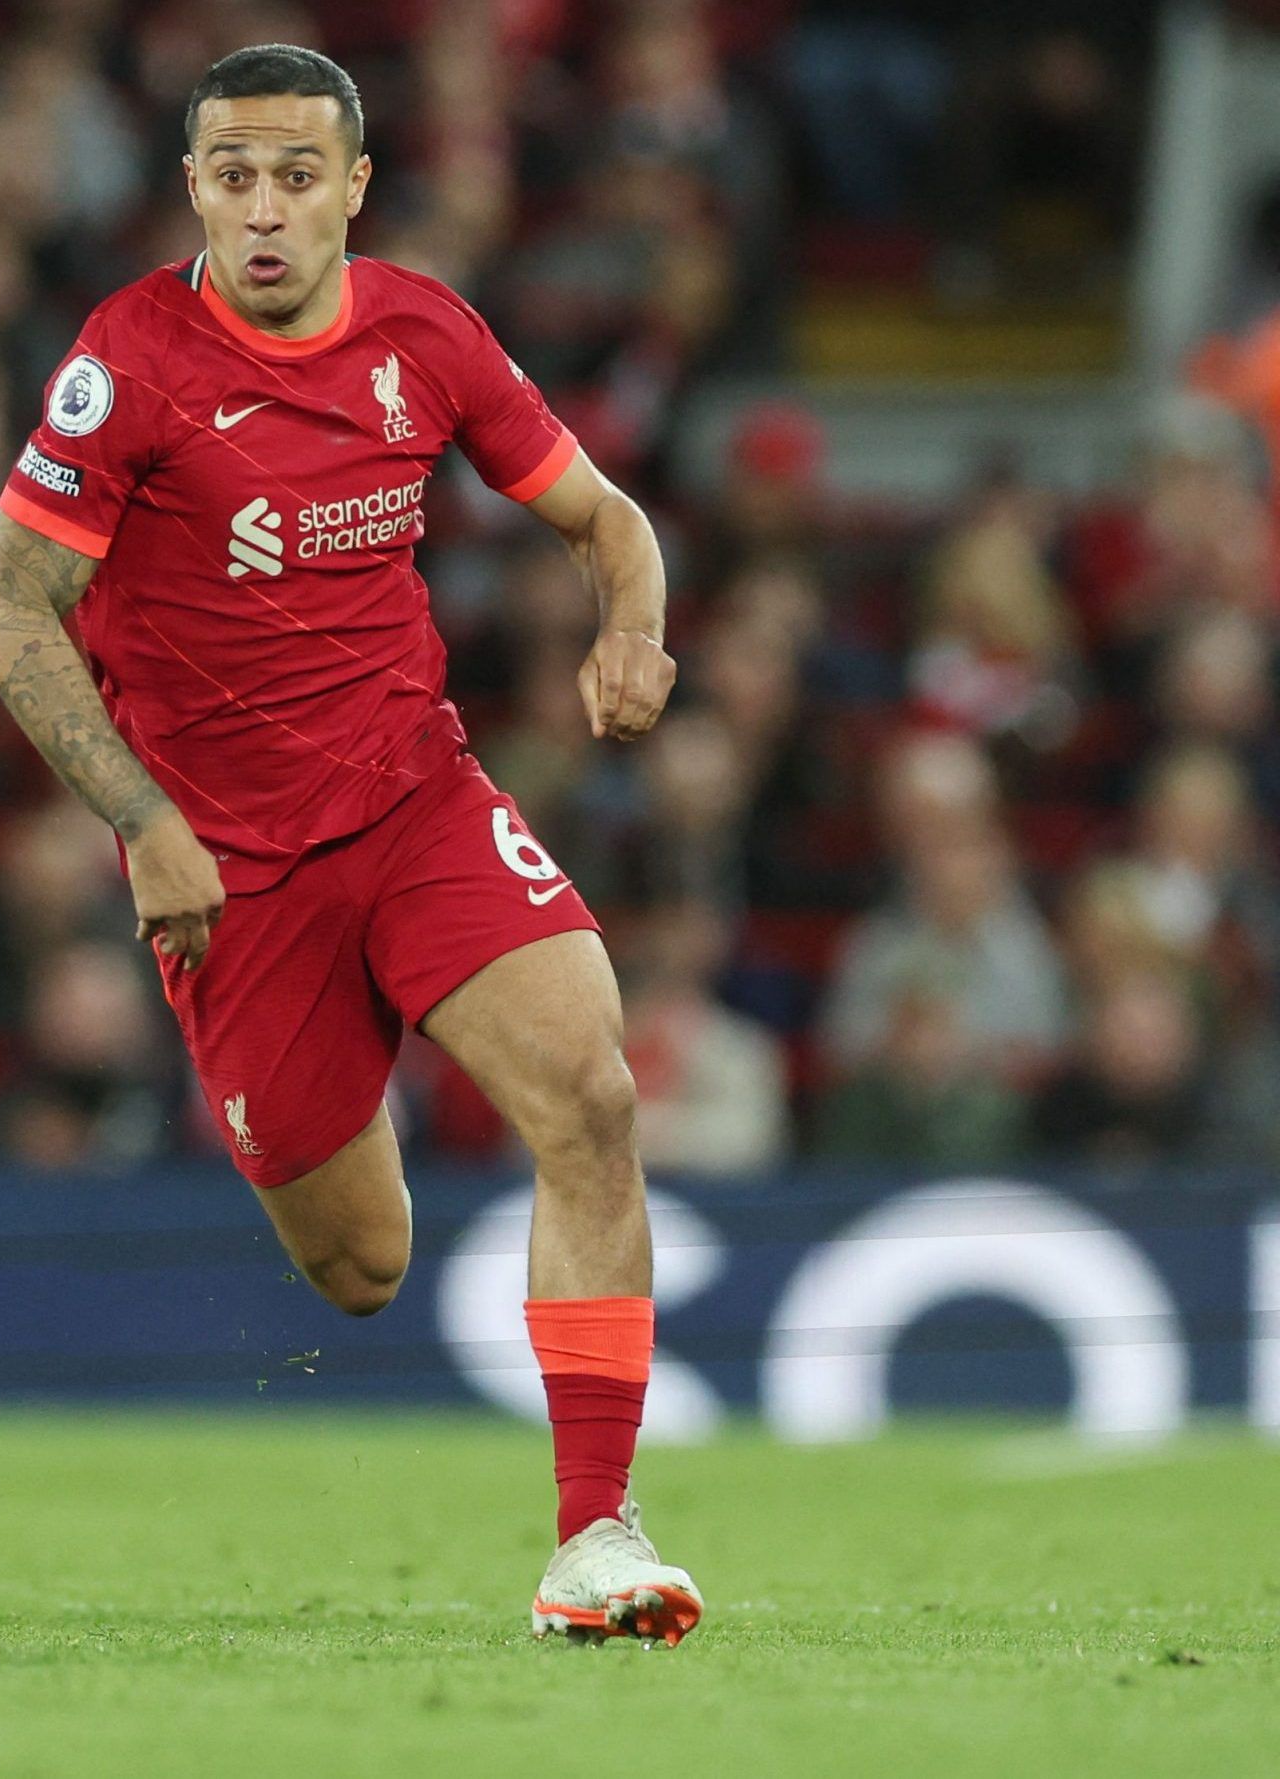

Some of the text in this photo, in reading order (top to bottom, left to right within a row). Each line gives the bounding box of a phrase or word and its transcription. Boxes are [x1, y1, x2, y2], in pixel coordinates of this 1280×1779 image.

[31, 467, 80, 497] racism
[35, 455, 76, 482] room
[297, 473, 426, 533] standard
[492, 807, 558, 881] 6
